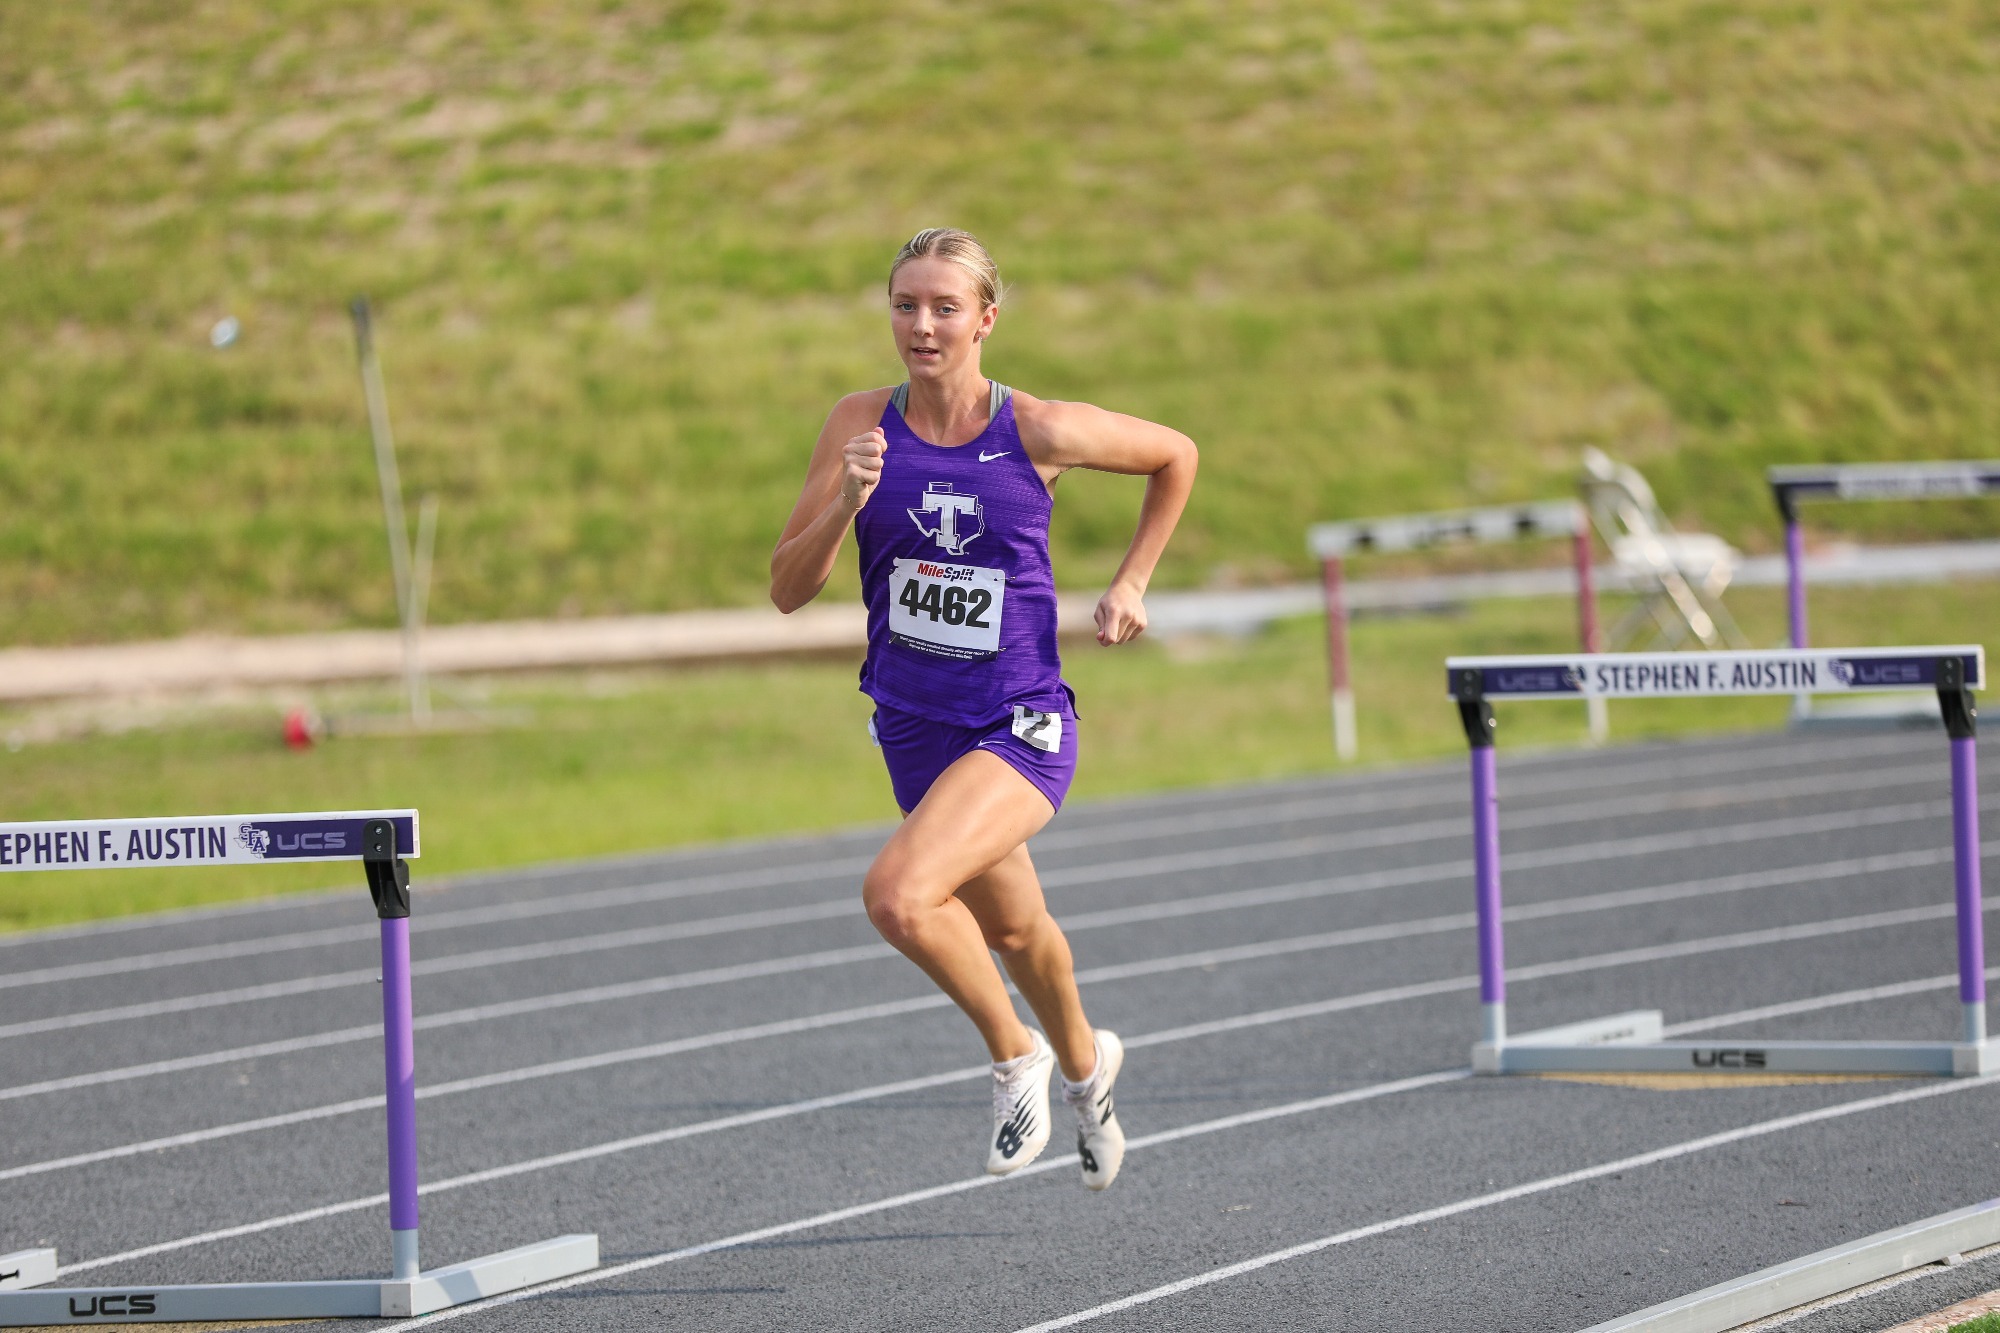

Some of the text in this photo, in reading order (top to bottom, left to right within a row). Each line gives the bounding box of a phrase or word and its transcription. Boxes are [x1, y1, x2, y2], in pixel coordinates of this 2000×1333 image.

[917, 562, 975, 582] MileSplit
[898, 578, 992, 629] 4462
[1497, 672, 1558, 691] UCS
[1596, 663, 1700, 692] STEPHEN
[1707, 661, 1725, 689] F.
[1731, 660, 1817, 689] AUSTIN
[1859, 663, 1921, 683] UCS
[98, 830, 119, 862] F.
[126, 826, 227, 861] AUSTIN
[276, 831, 347, 851] UCS
[1692, 1048, 1767, 1069] UCS
[69, 1294, 157, 1317] UCS
